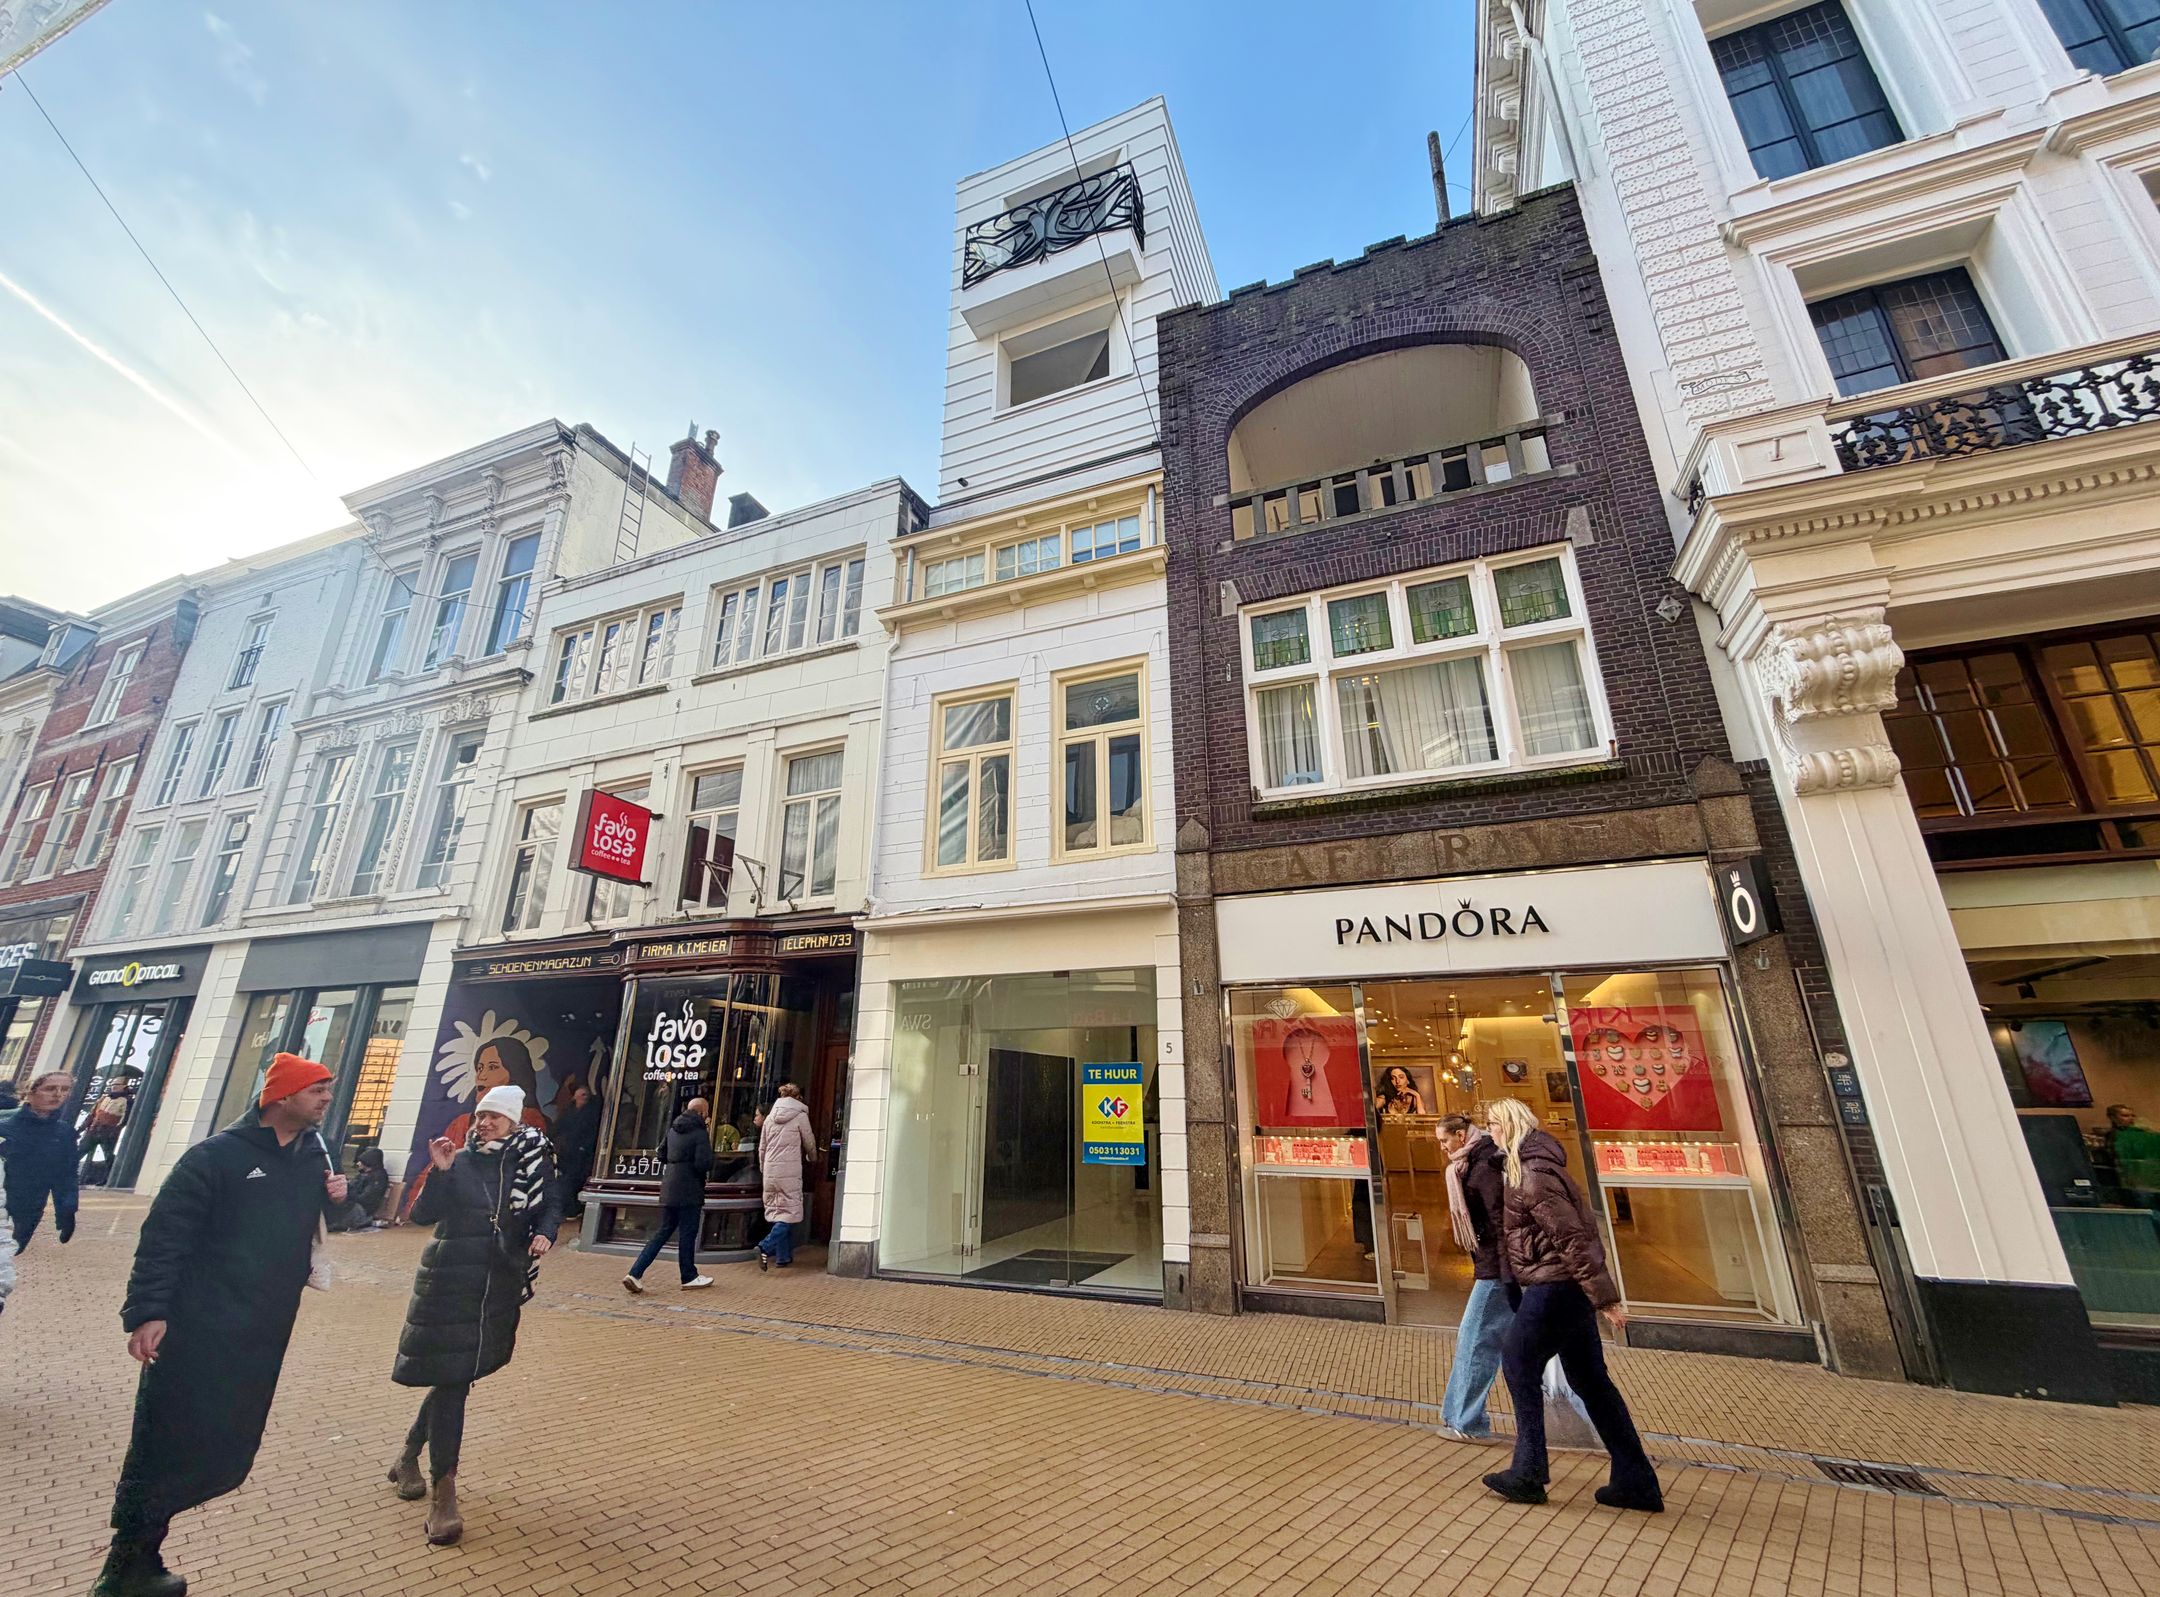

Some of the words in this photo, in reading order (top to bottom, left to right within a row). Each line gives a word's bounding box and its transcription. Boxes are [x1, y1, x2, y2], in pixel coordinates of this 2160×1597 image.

[594, 813, 637, 842] favo
[593, 830, 636, 858] losa
[591, 849, 611, 860] coffee
[620, 857, 631, 866] tea
[1335, 903, 1550, 945] PANDORA
[642, 944, 673, 957] FIRMA
[647, 1012, 707, 1042] favo
[645, 1041, 707, 1068] losa
[1166, 1042, 1173, 1054] 5
[643, 1069, 671, 1081] coffee
[684, 1070, 698, 1080] tea
[1088, 1069, 1102, 1080] TE
[1104, 1069, 1137, 1080] HUUR
